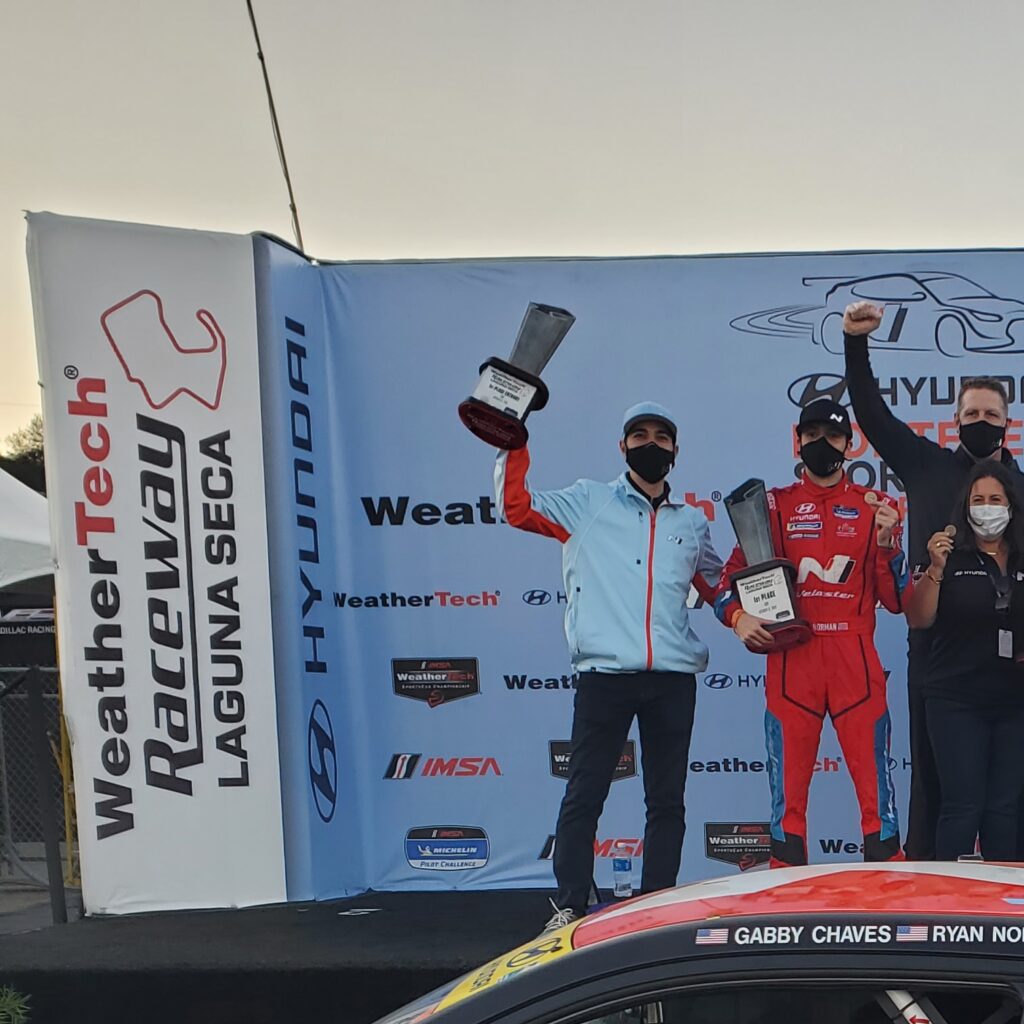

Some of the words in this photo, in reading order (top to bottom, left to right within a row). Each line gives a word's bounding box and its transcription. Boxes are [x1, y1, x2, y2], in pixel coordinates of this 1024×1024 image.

[200, 430, 238, 567] SECA
[285, 316, 328, 674] HYUNDAI
[137, 413, 204, 798] Raceway
[203, 577, 250, 789] LAGUNA
[421, 756, 502, 777] IMSA
[735, 927, 804, 945] GABBY
[811, 925, 891, 945] CHAVES
[932, 926, 984, 943] RYAN
